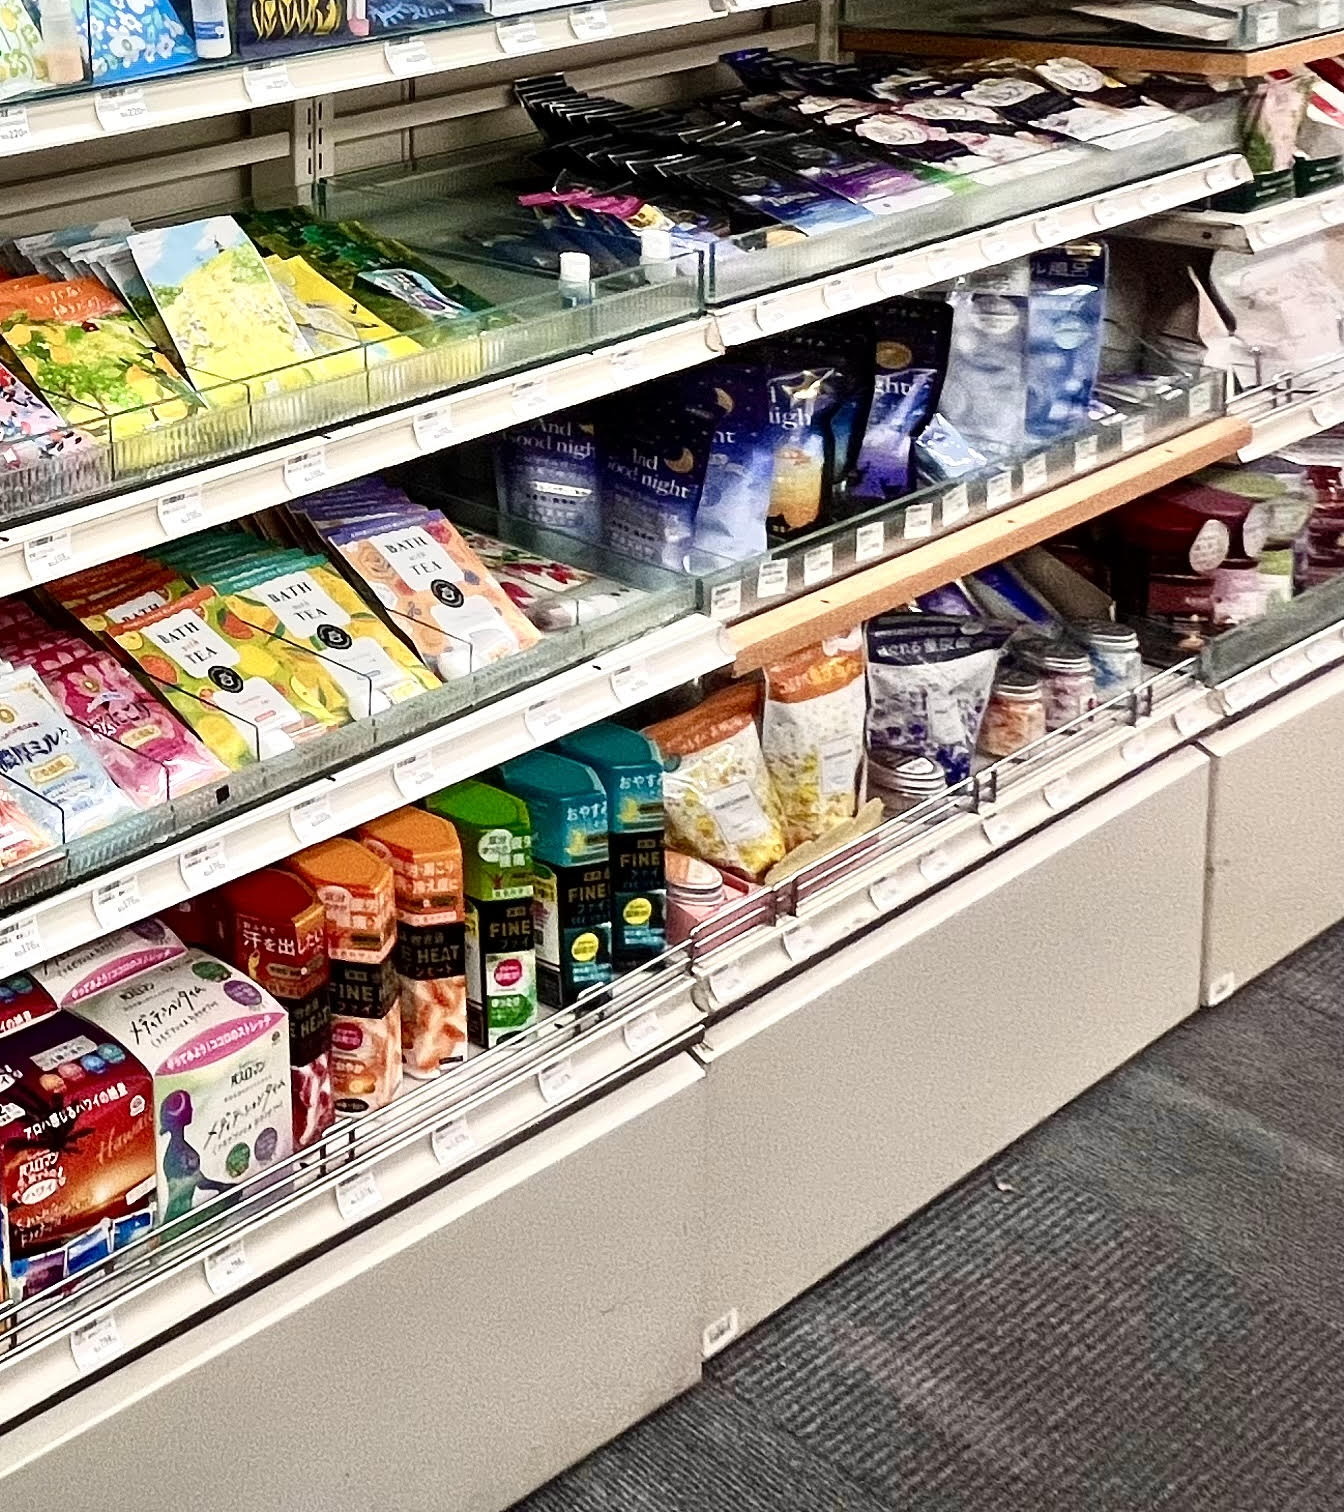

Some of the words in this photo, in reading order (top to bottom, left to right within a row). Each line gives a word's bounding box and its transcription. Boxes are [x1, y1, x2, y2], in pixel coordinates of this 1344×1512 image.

[532, 417, 572, 437] And
[382, 535, 428, 554] BATH
[410, 559, 443, 577] TEA
[266, 580, 313, 603] BATH
[292, 605, 328, 621] TEA
[156, 622, 199, 646] BATH
[184, 646, 217, 665] TEA
[620, 852, 661, 869] FINE
[568, 883, 607, 904] FINE
[488, 920, 531, 939] FINE
[417, 943, 461, 966] HEAT
